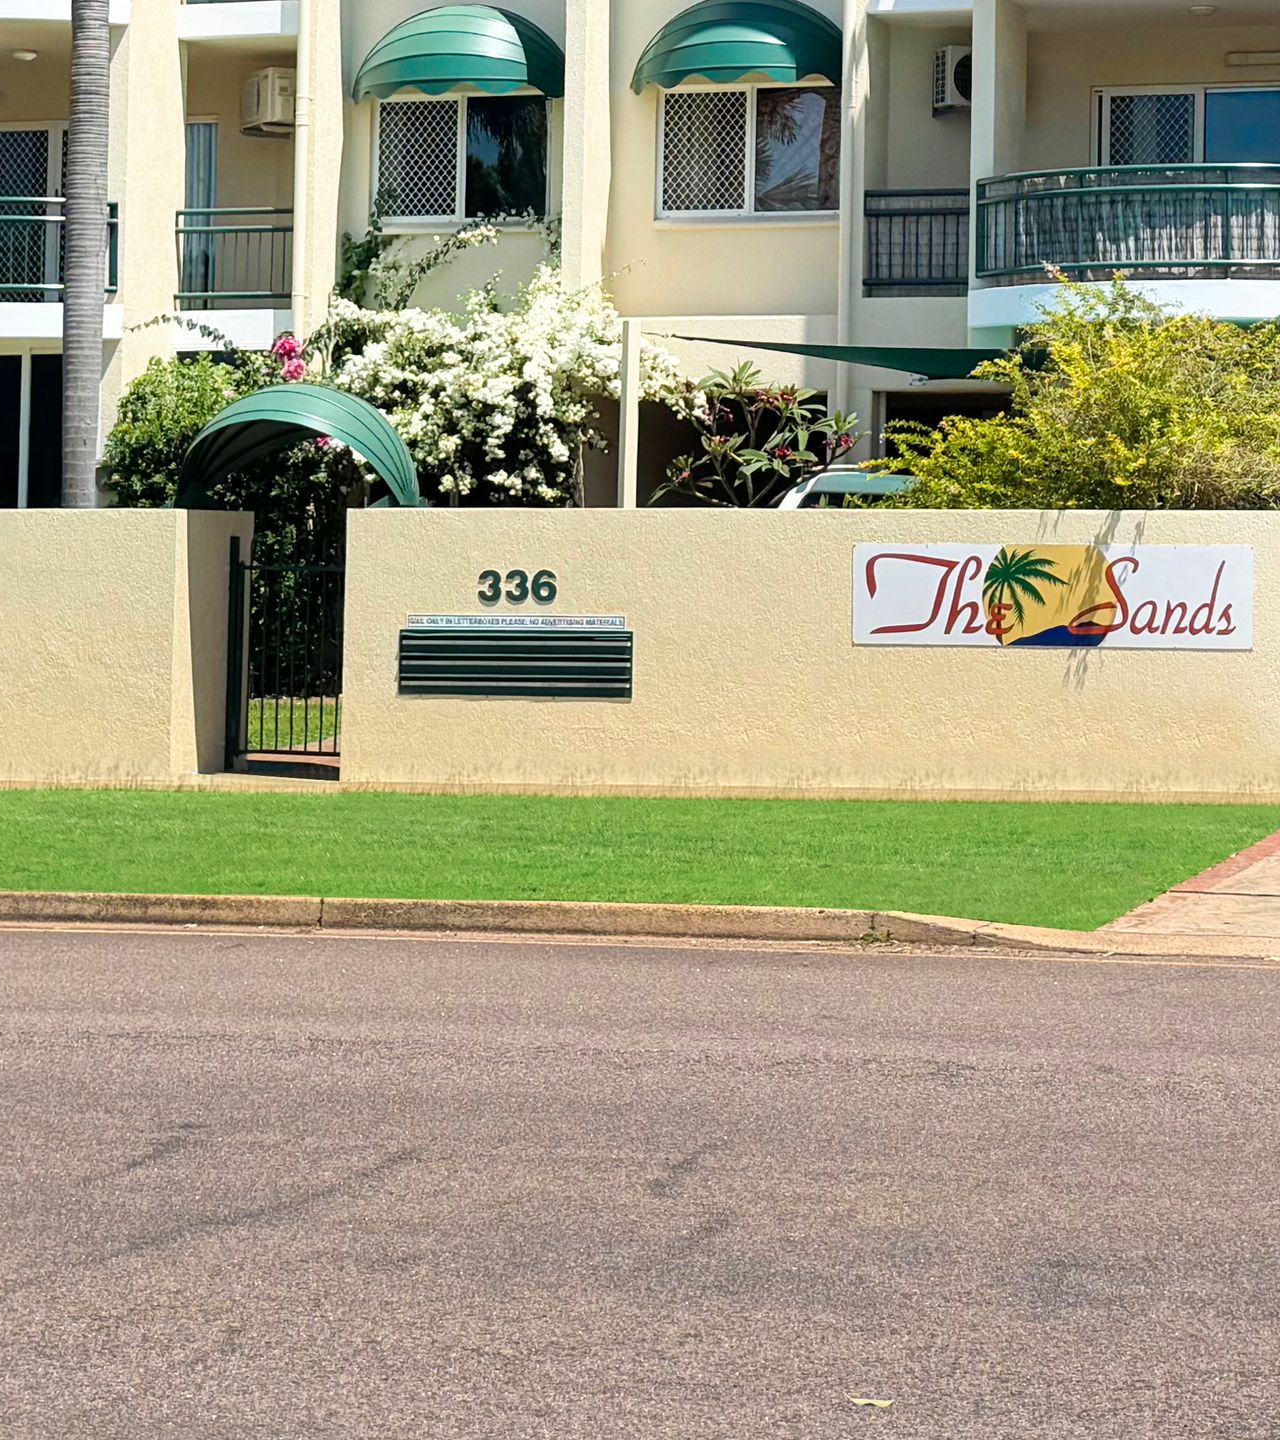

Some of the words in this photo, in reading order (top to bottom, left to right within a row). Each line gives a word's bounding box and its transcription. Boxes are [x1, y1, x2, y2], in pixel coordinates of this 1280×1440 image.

[478, 569, 557, 605] 336
[865, 552, 1017, 636] The
[1068, 556, 1237, 636] Sands
[426, 617, 445, 625] ONLY
